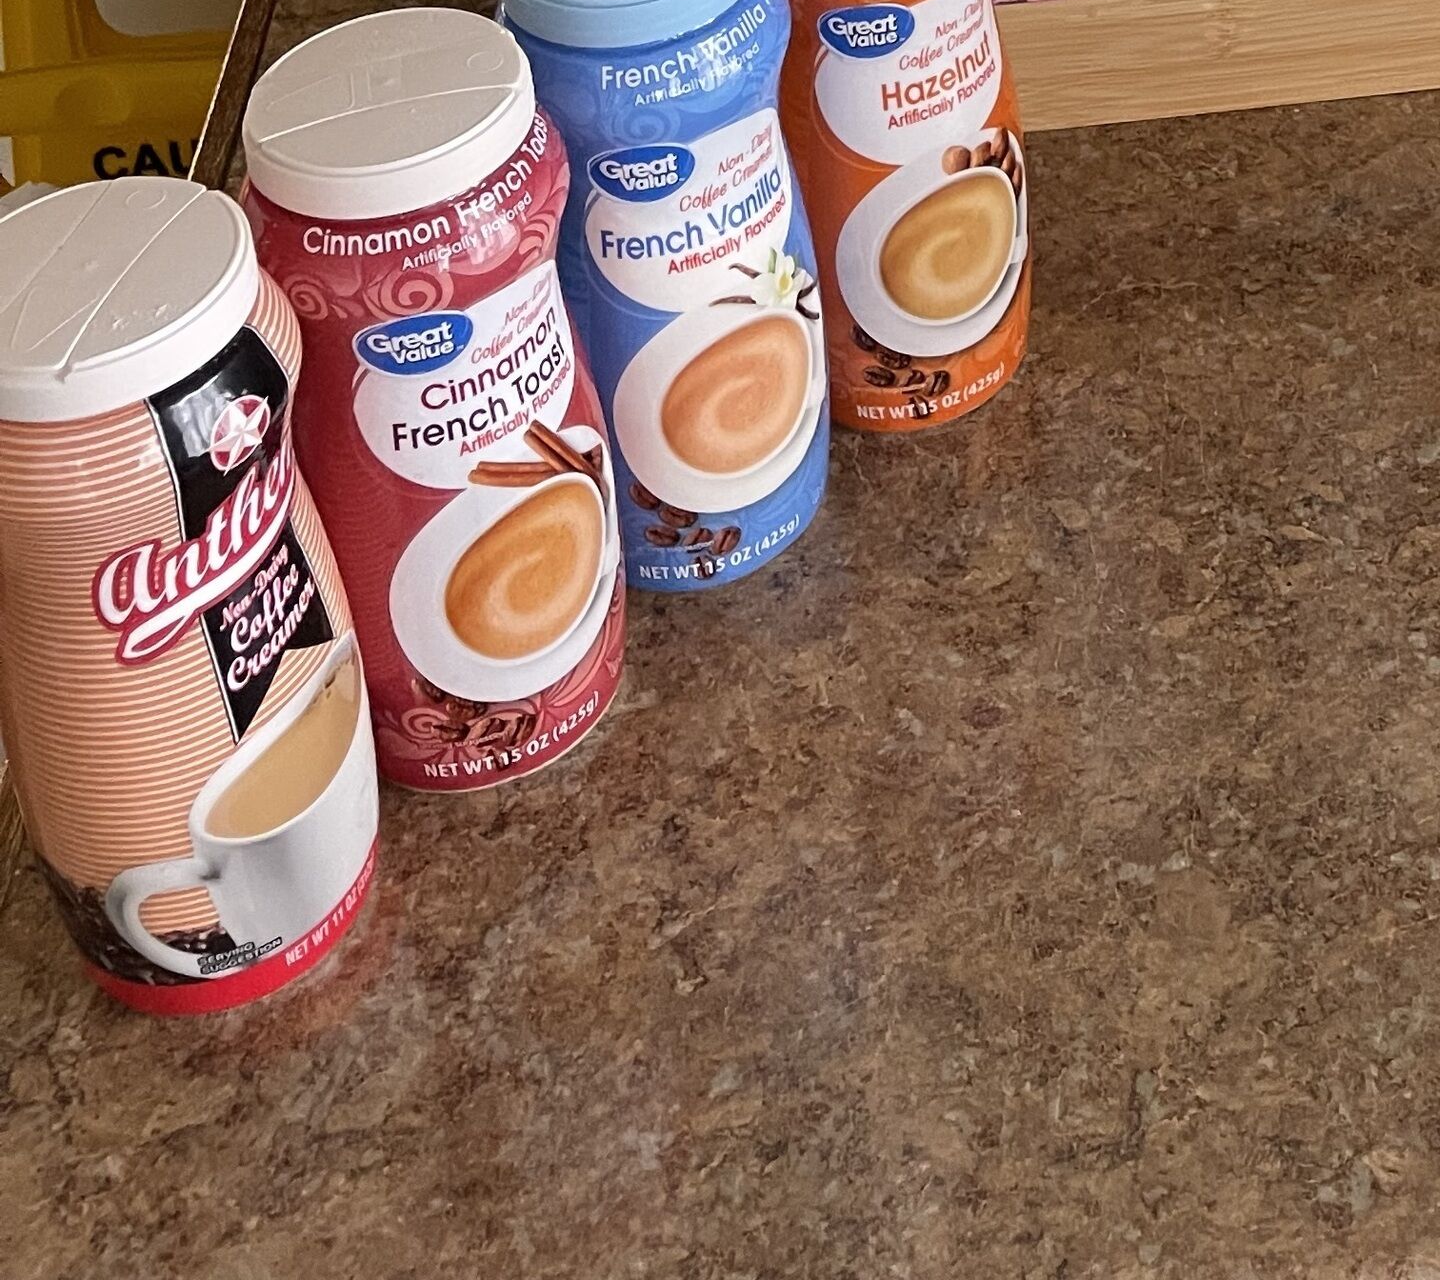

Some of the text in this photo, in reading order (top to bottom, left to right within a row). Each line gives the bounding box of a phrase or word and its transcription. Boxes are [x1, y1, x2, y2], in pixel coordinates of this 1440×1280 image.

[827, 13, 898, 36] Great
[846, 31, 898, 48] Value
[601, 47, 699, 91] French
[881, 31, 991, 111] Hazelnut
[899, 45, 943, 71] Coffee
[887, 93, 955, 130] Artificially
[599, 152, 678, 180] Great
[619, 171, 679, 191] Value
[303, 215, 451, 257] Cinnamon
[453, 161, 533, 227] French
[600, 165, 782, 260] French Vanilla
[679, 180, 728, 213] Coffee
[667, 233, 742, 275] Artificially
[366, 321, 453, 354] Great
[390, 343, 455, 365] Value
[420, 306, 556, 410] Cinnamon
[471, 330, 513, 365] Coffee
[392, 331, 566, 452] French Toast
[856, 361, 1005, 420] NET WT 15 OZ (425g)
[459, 407, 530, 458] Artificially
[639, 565, 669, 580] NET
[672, 563, 700, 580] WT
[703, 557, 726, 575] 15
[729, 545, 753, 567] OZ
[754, 514, 800, 557] (425g)
[230, 563, 299, 653] Coffee
[226, 576, 315, 692] Creamer
[423, 762, 458, 779] NET
[462, 754, 494, 776] WT
[498, 748, 523, 766] 15
[526, 733, 550, 756] OZ
[551, 690, 600, 742] (425g)
[199, 942, 254, 967] SERVING
[201, 937, 282, 975] SUGGESTION
[285, 937, 310, 967] NET
[311, 922, 330, 946] WT
